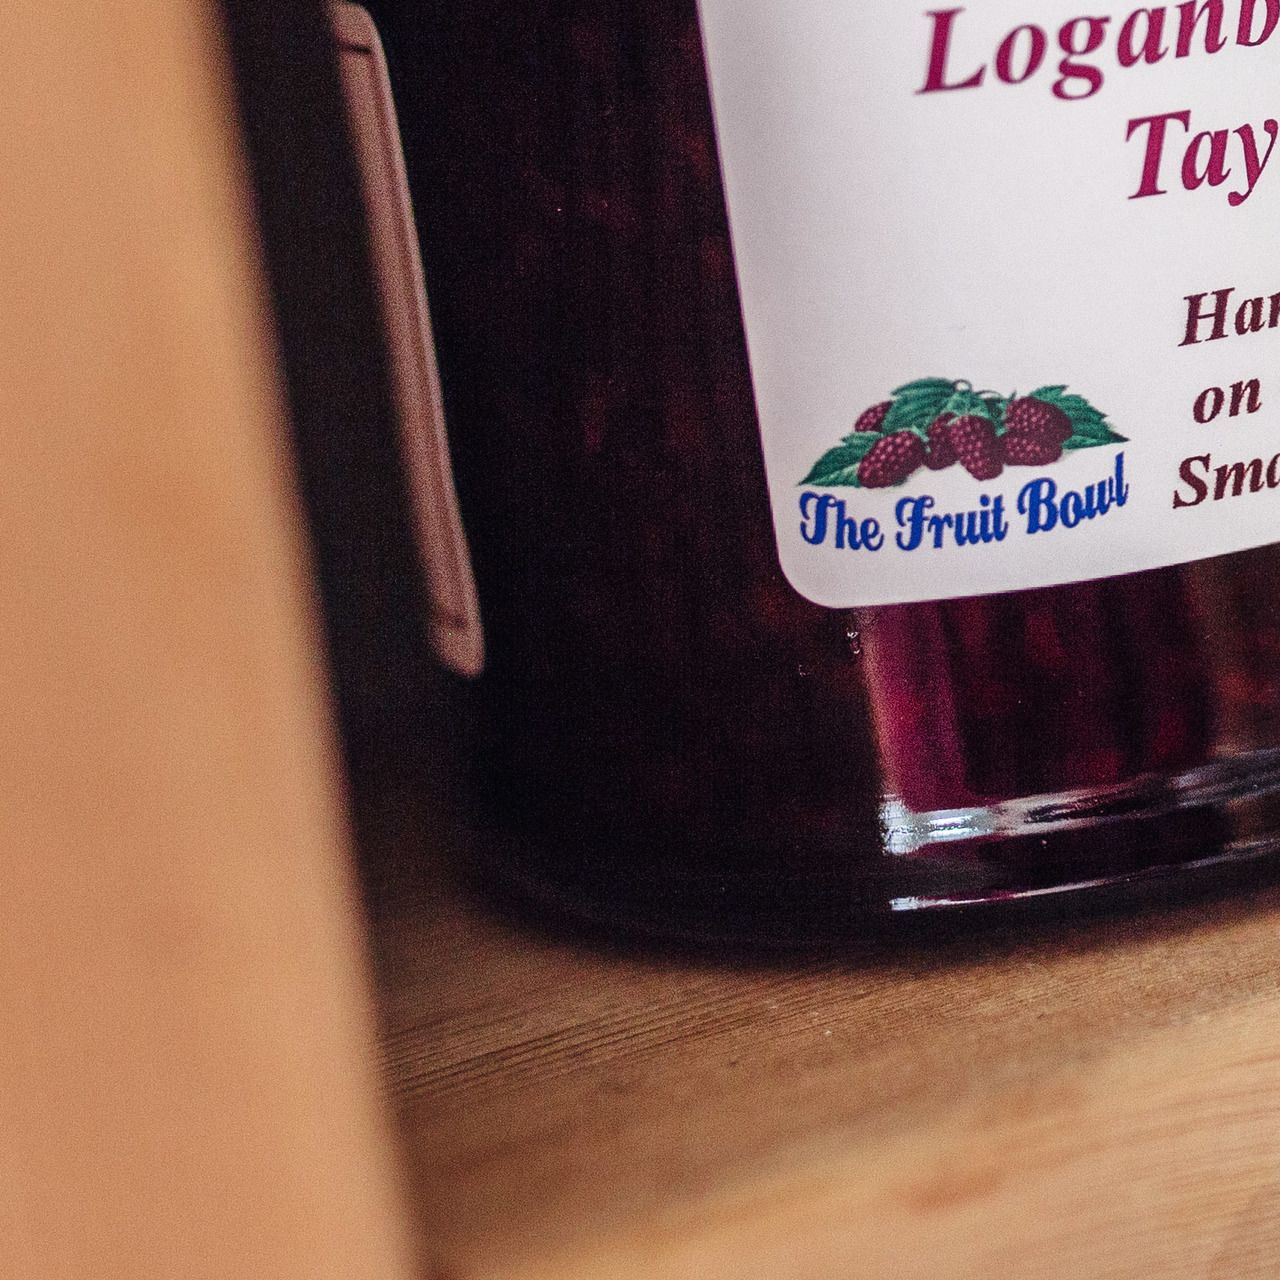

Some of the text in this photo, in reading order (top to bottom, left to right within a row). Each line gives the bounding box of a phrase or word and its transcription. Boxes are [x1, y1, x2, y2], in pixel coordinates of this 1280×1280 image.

[1192, 376, 1263, 424] on
[799, 450, 1130, 552] The Fruit Bowl
